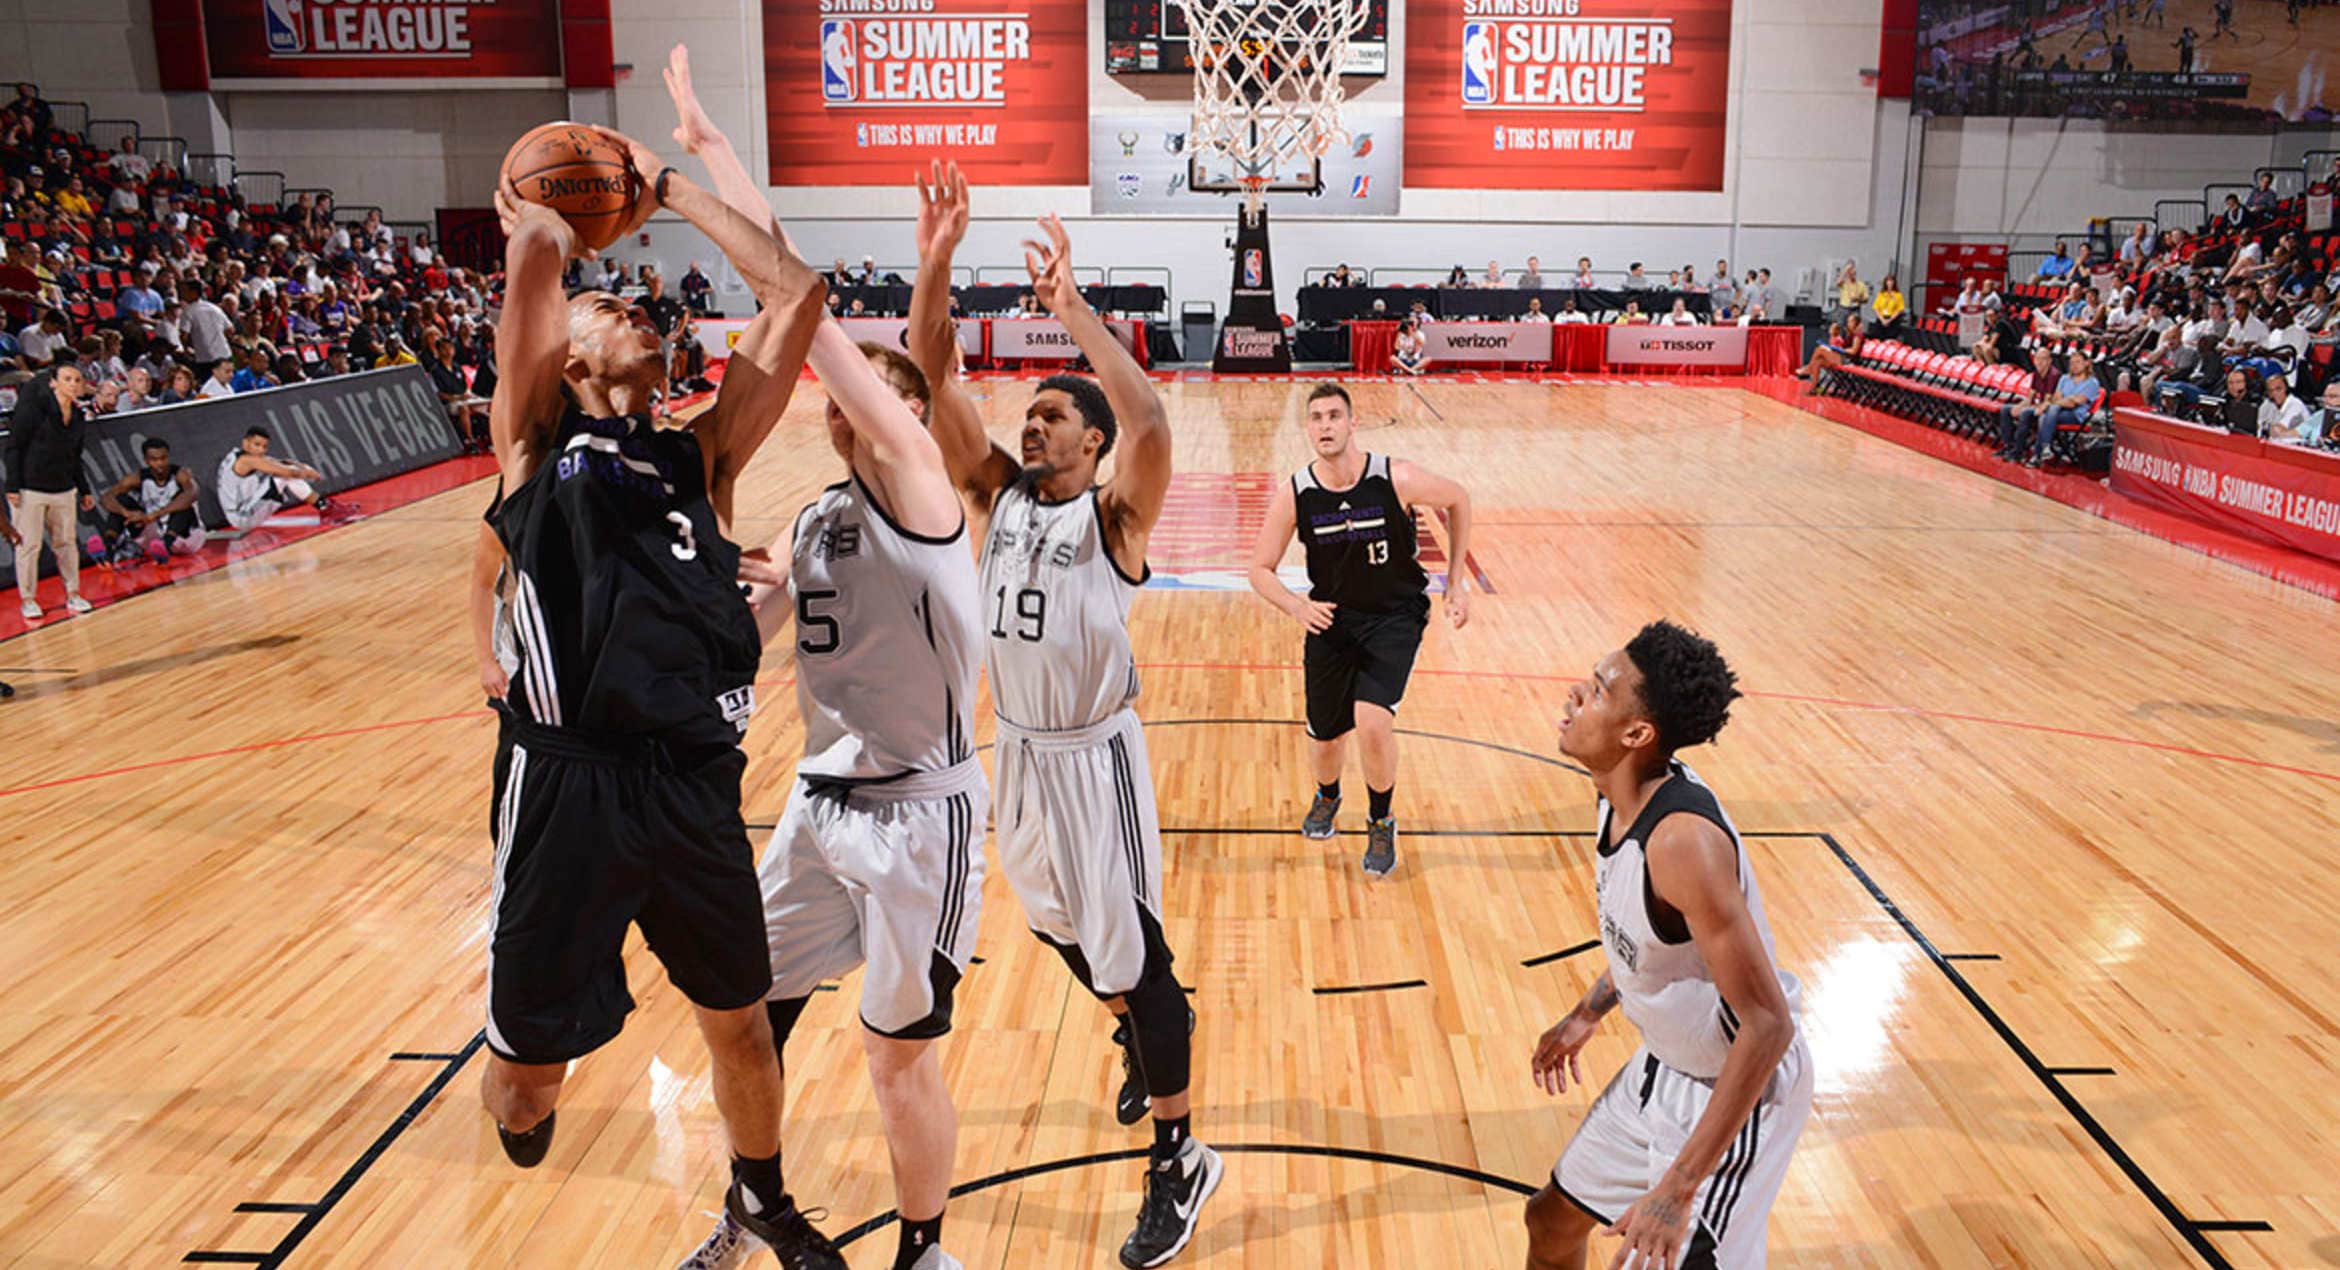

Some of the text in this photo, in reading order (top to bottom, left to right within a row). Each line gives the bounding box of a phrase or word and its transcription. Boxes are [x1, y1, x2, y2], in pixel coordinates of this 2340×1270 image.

[820, 0, 934, 11] SAMSUNG
[1463, 0, 1580, 16] SAMSUNG
[311, 7, 472, 51] LEAGUE
[863, 21, 1029, 59] SUMMER
[1505, 24, 1673, 64] SUMMER
[863, 62, 1005, 100] LEAGUE
[1504, 66, 1645, 104] LEAGUE
[870, 124, 997, 145] THIS IS WHY WE PLAY
[1508, 129, 1635, 150] THIS IS WHY WE PLAY
[538, 175, 626, 201] PALDING
[1447, 333, 1508, 349] verizon
[1661, 340, 1715, 351] TISSOT
[266, 380, 450, 483] LAS VEGAS
[2115, 446, 2182, 488] SAMSUNG
[2191, 466, 2218, 500] NBA
[2219, 475, 2285, 521] SUMMER
[666, 511, 697, 560] 3
[1368, 540, 1389, 565] 13
[797, 589, 840, 654] 5
[991, 585, 1046, 643] 19
